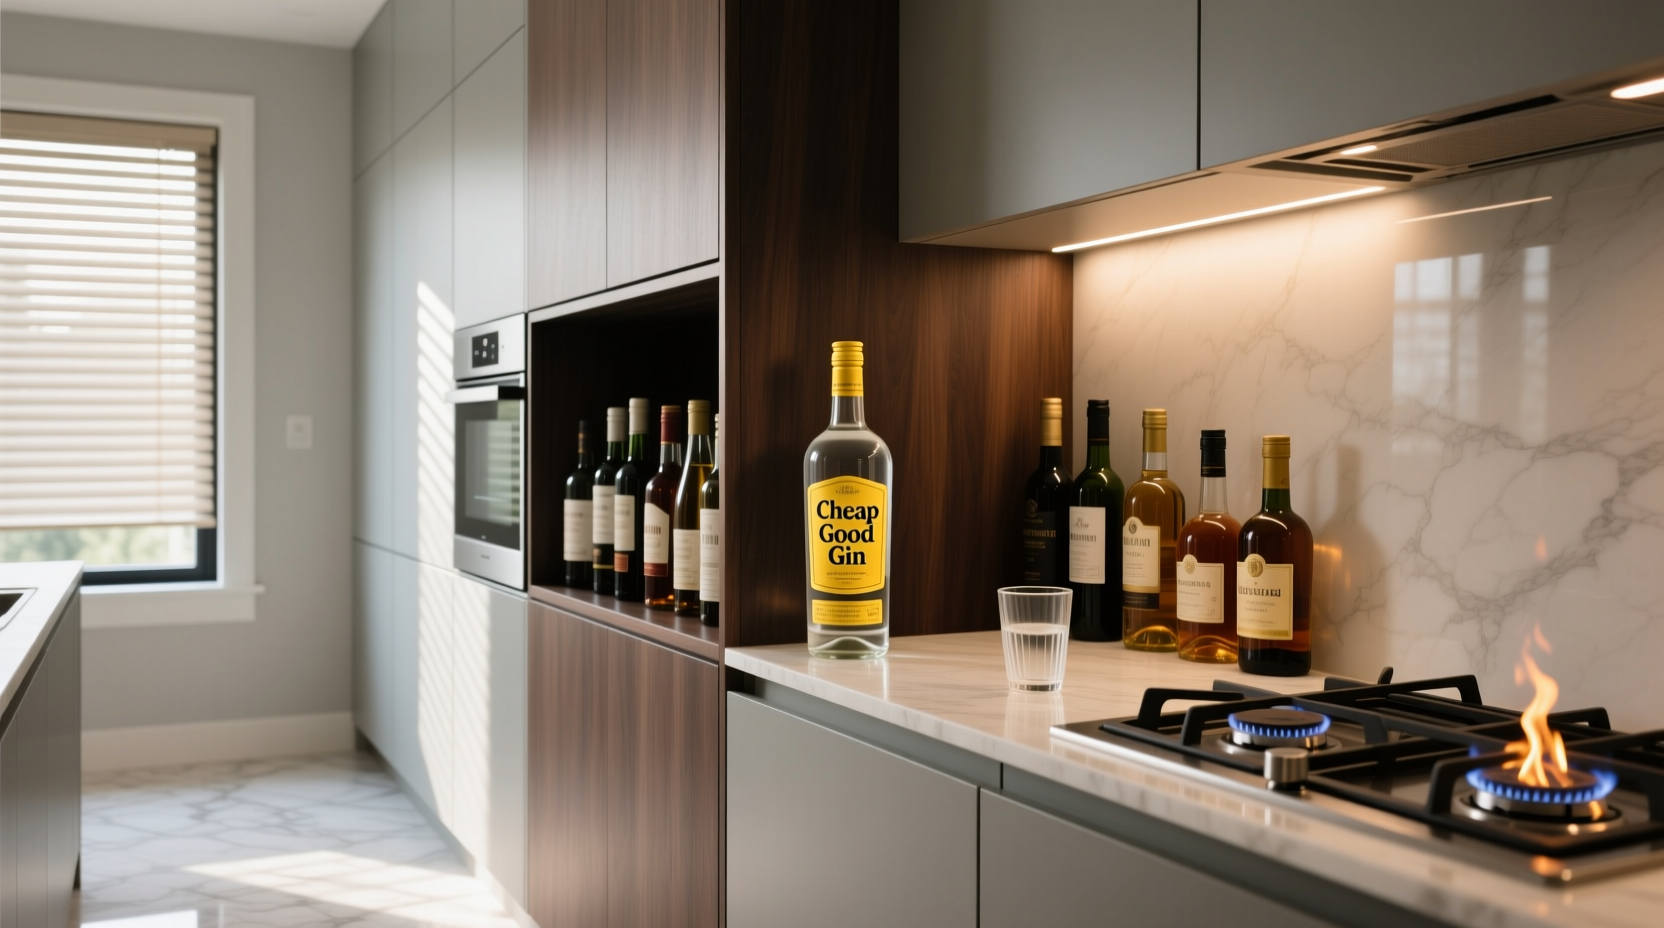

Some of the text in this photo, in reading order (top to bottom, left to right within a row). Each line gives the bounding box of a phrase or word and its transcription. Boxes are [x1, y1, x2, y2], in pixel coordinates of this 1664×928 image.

[817, 500, 879, 524] Cheap
[819, 524, 875, 543] Good
[828, 545, 866, 565] Gin
